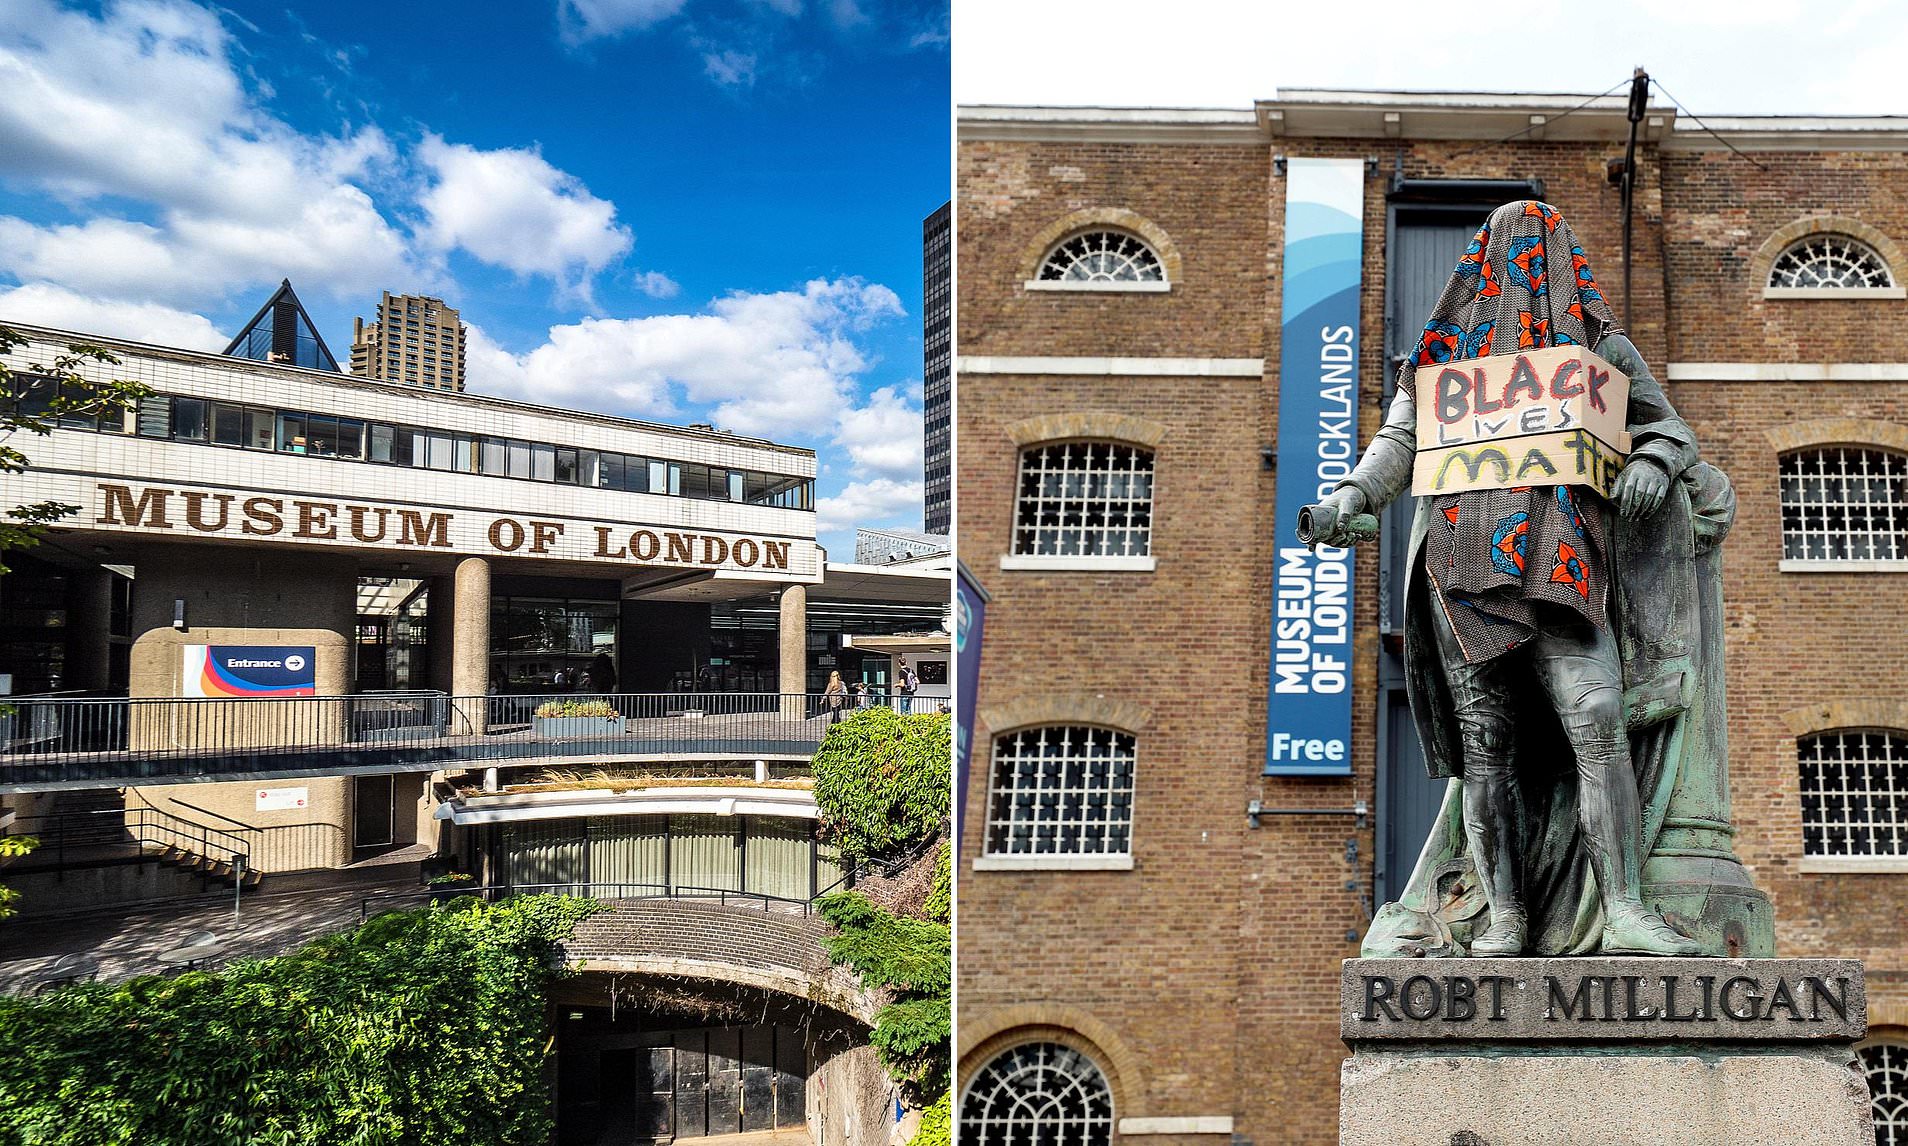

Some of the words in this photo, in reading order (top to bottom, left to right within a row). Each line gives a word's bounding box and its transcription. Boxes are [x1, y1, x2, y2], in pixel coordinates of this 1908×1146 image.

[1435, 355, 1610, 424] BLACK
[96, 483, 454, 547] MUSEUM
[488, 518, 564, 553] OF
[593, 526, 791, 569] LONDON
[1274, 547, 1313, 694] MUSEUM
[1313, 541, 1349, 644] LONDO
[227, 658, 282, 668] Entrance
[1311, 652, 1346, 694] OF
[1272, 733, 1345, 761] Free
[1359, 975, 1516, 1022] ROBT
[1544, 975, 1849, 1022] MILLIGAN
